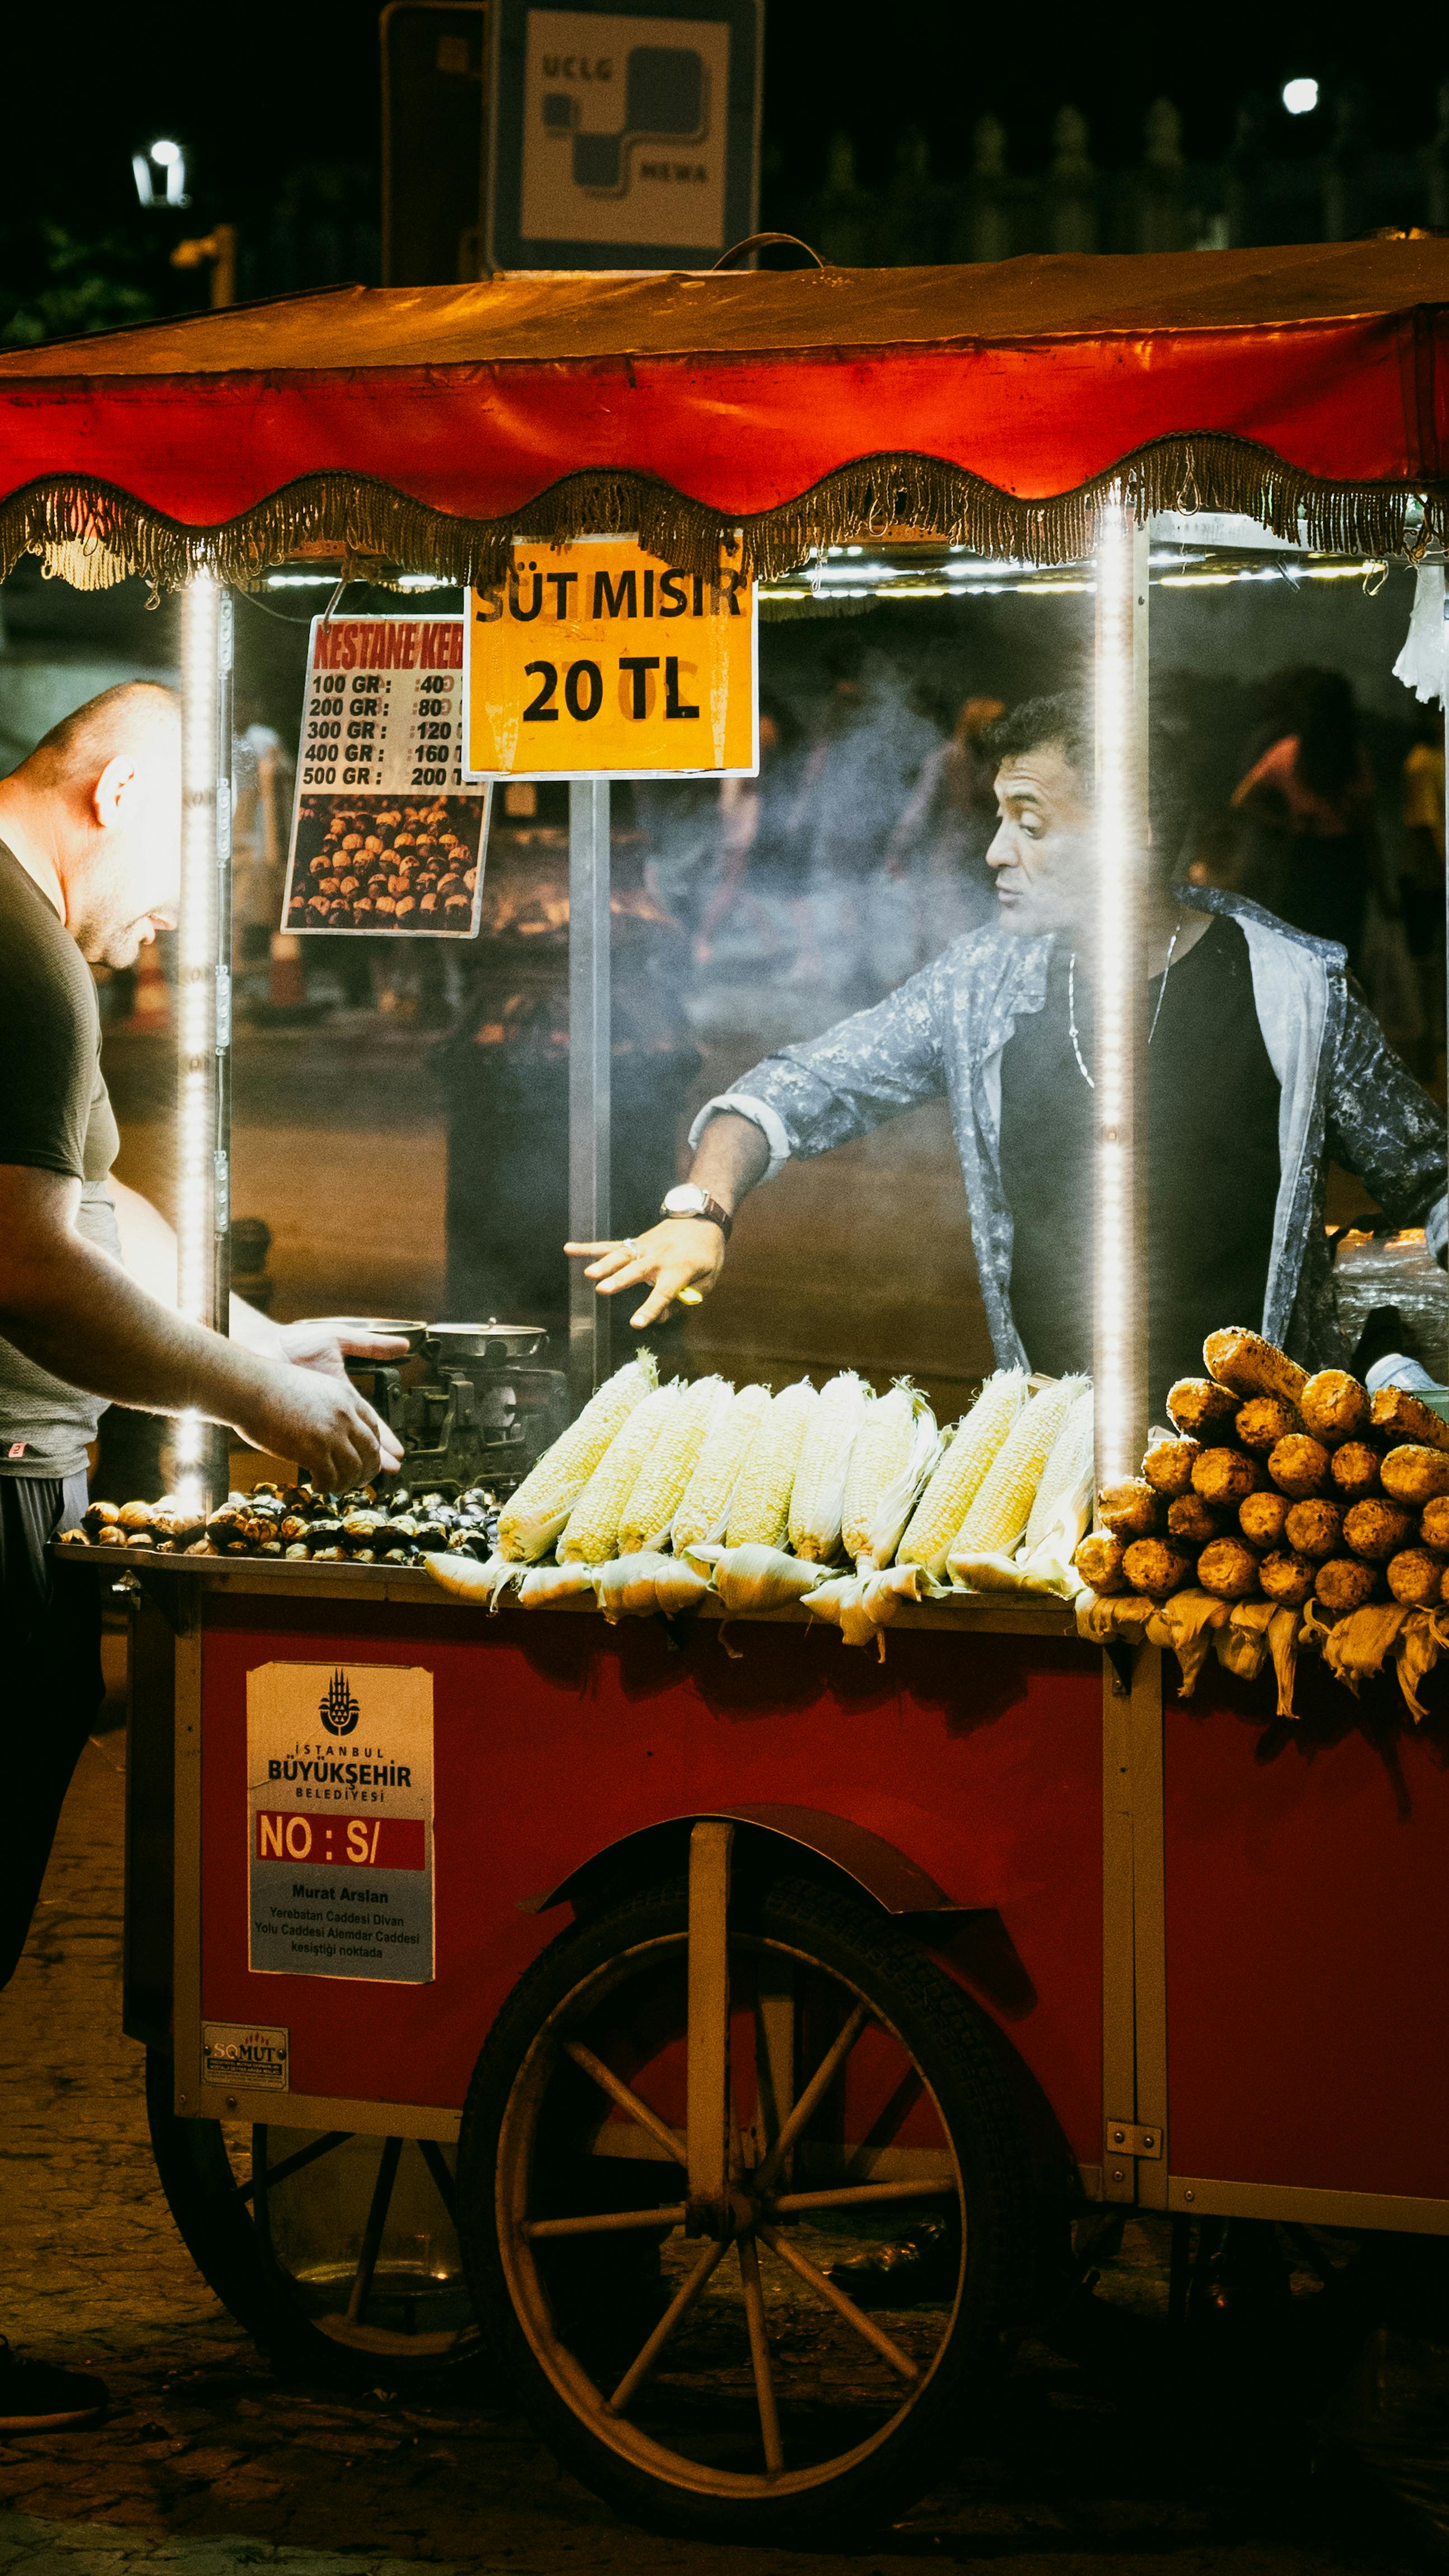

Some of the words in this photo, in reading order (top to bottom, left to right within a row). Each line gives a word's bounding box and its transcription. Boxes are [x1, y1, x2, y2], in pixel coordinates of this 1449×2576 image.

[542, 55, 613, 81] UCLG
[476, 561, 578, 622] SÜT
[593, 567, 740, 619] MISIR
[313, 622, 417, 670] KESTANE
[312, 675, 346, 693] 100
[421, 675, 444, 693] 40
[523, 659, 603, 722] 20
[619, 656, 700, 720] TL
[309, 699, 343, 716] 200
[418, 699, 441, 717] 80
[307, 721, 341, 739] 300
[417, 722, 451, 739] 120
[305, 744, 338, 762] 400
[415, 745, 449, 762] 160
[303, 767, 336, 785] 500
[411, 768, 446, 786] 200
[295, 1742, 384, 1758] İSTANBUL
[268, 1754, 411, 1790] BÜYÜKŞEHİR
[296, 1788, 384, 1802] BELEDİYESİ
[260, 1815, 312, 1859] NO
[346, 1820, 380, 1864] S/
[292, 1884, 335, 1900] Murat
[340, 1888, 388, 1903] Arslan
[270, 1906, 323, 1921] Yerebatan
[327, 1911, 370, 1925] Caddesi
[374, 1914, 404, 1927] Divan
[255, 1921, 278, 1934] Yolu
[281, 1924, 324, 1938] Caddesi
[376, 1931, 420, 1944] Caddesi
[340, 1945, 383, 1958] noktada
